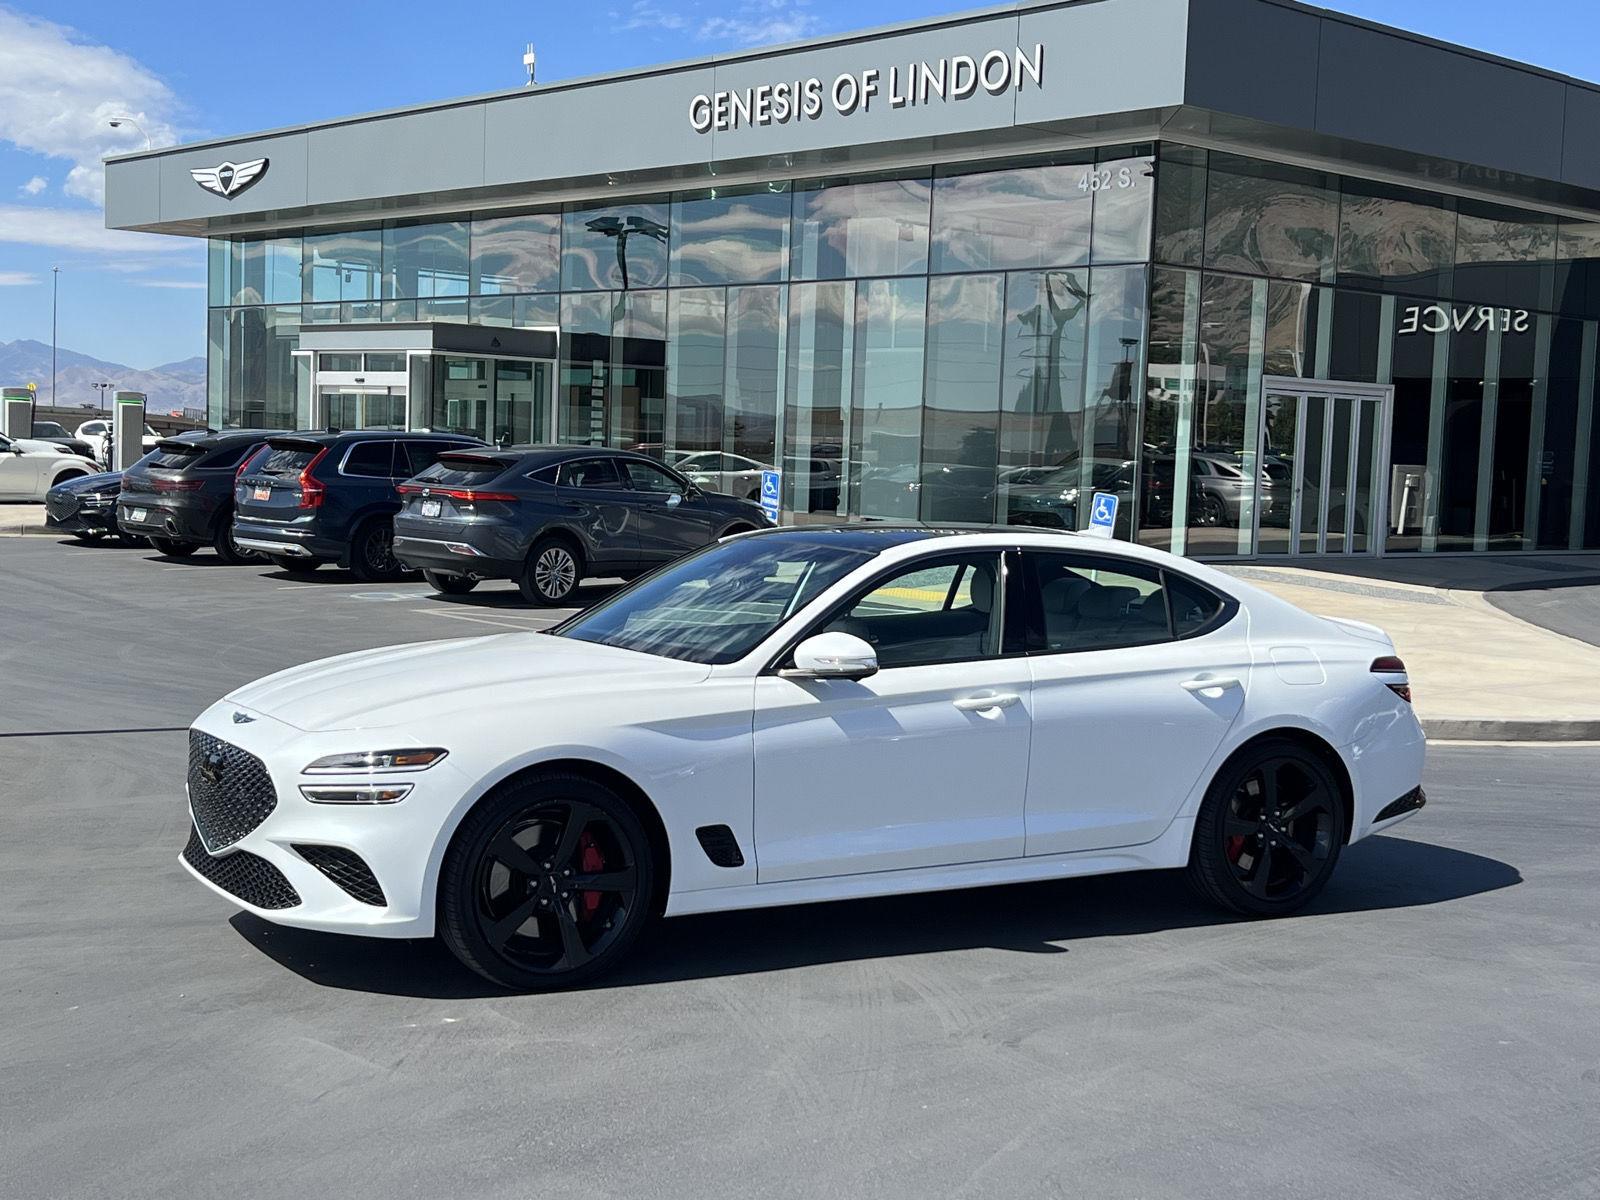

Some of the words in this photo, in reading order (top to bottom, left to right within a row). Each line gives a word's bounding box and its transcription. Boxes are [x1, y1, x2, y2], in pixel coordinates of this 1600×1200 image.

[688, 77, 823, 134] GENESIS
[831, 69, 880, 116] OF
[888, 43, 1044, 109] LINDON
[1118, 167, 1136, 188] S.
